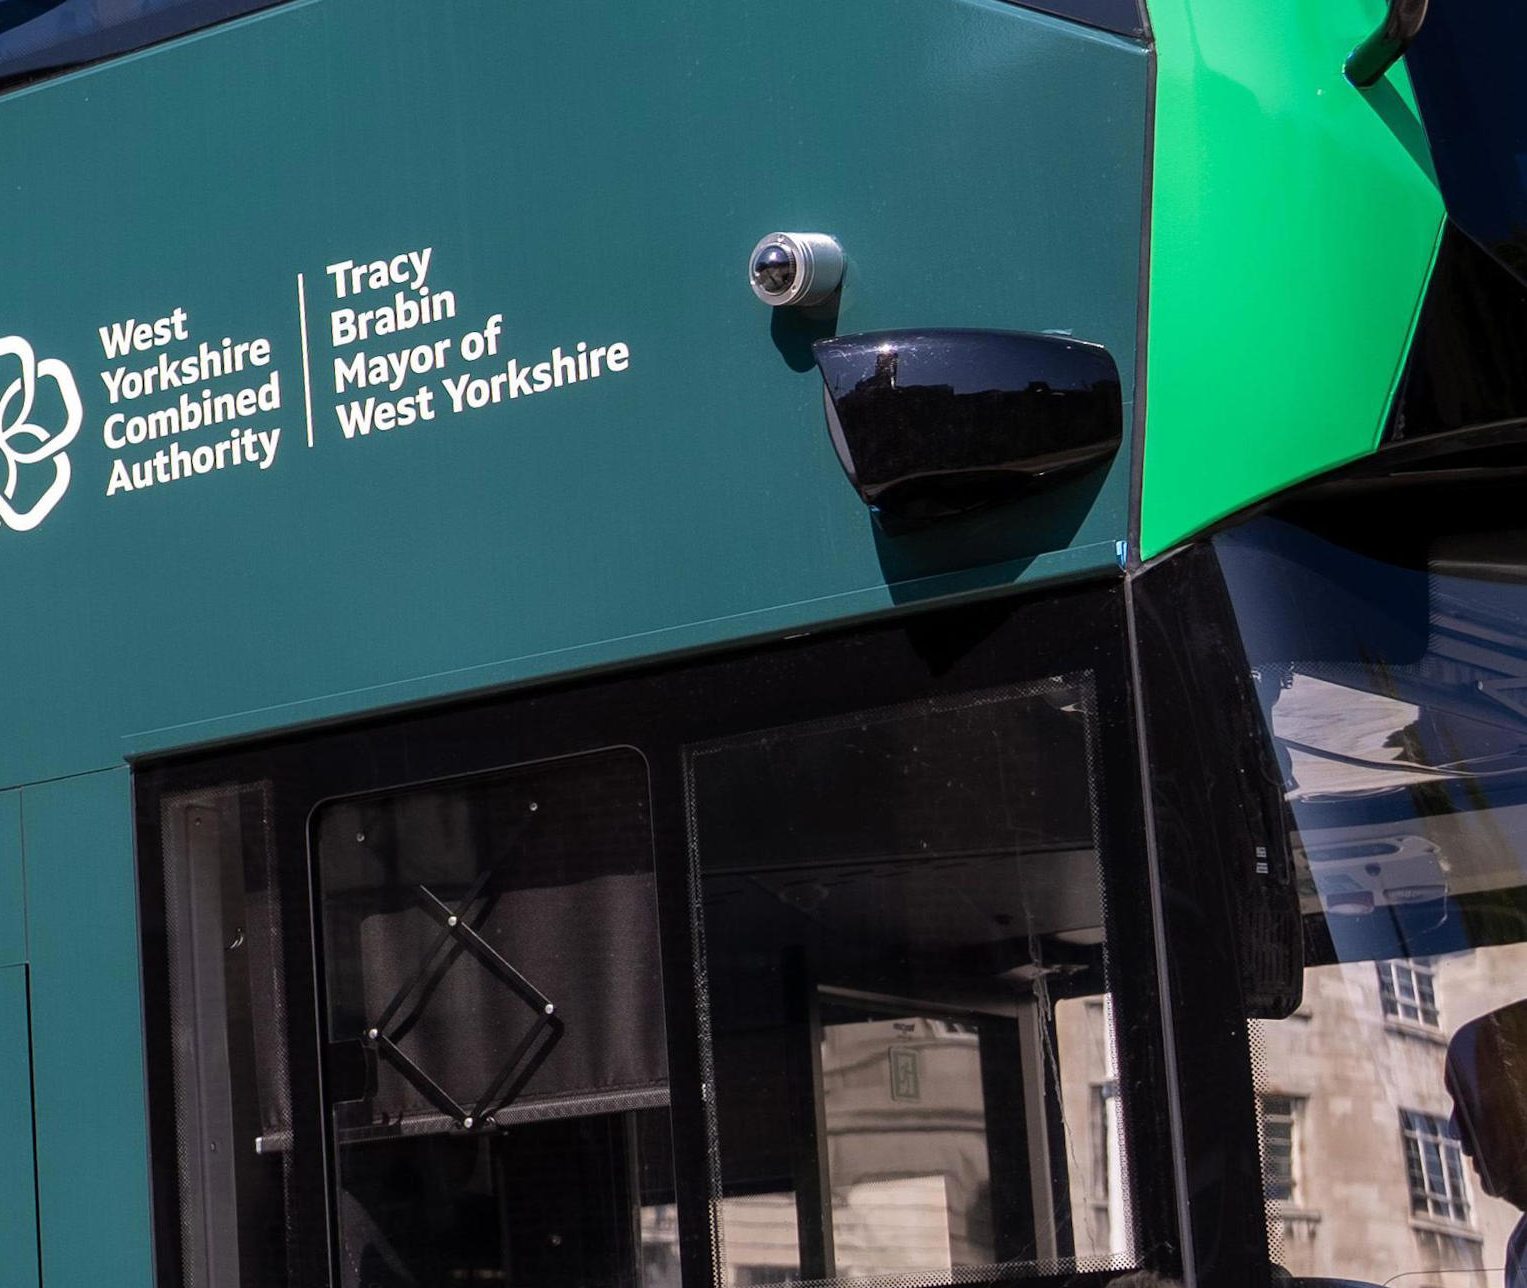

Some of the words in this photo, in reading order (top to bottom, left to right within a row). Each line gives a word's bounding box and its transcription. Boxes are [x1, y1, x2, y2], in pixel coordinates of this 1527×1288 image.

[327, 248, 432, 299] Tracy
[99, 308, 188, 360] West
[331, 287, 456, 347] Brabin
[101, 337, 271, 404] Yorkshire
[334, 338, 452, 394] Mayor
[461, 314, 503, 361] of
[104, 371, 281, 450] Combined
[336, 386, 435, 439] West
[442, 341, 630, 413] Yorkshire
[107, 427, 281, 497] Authority
